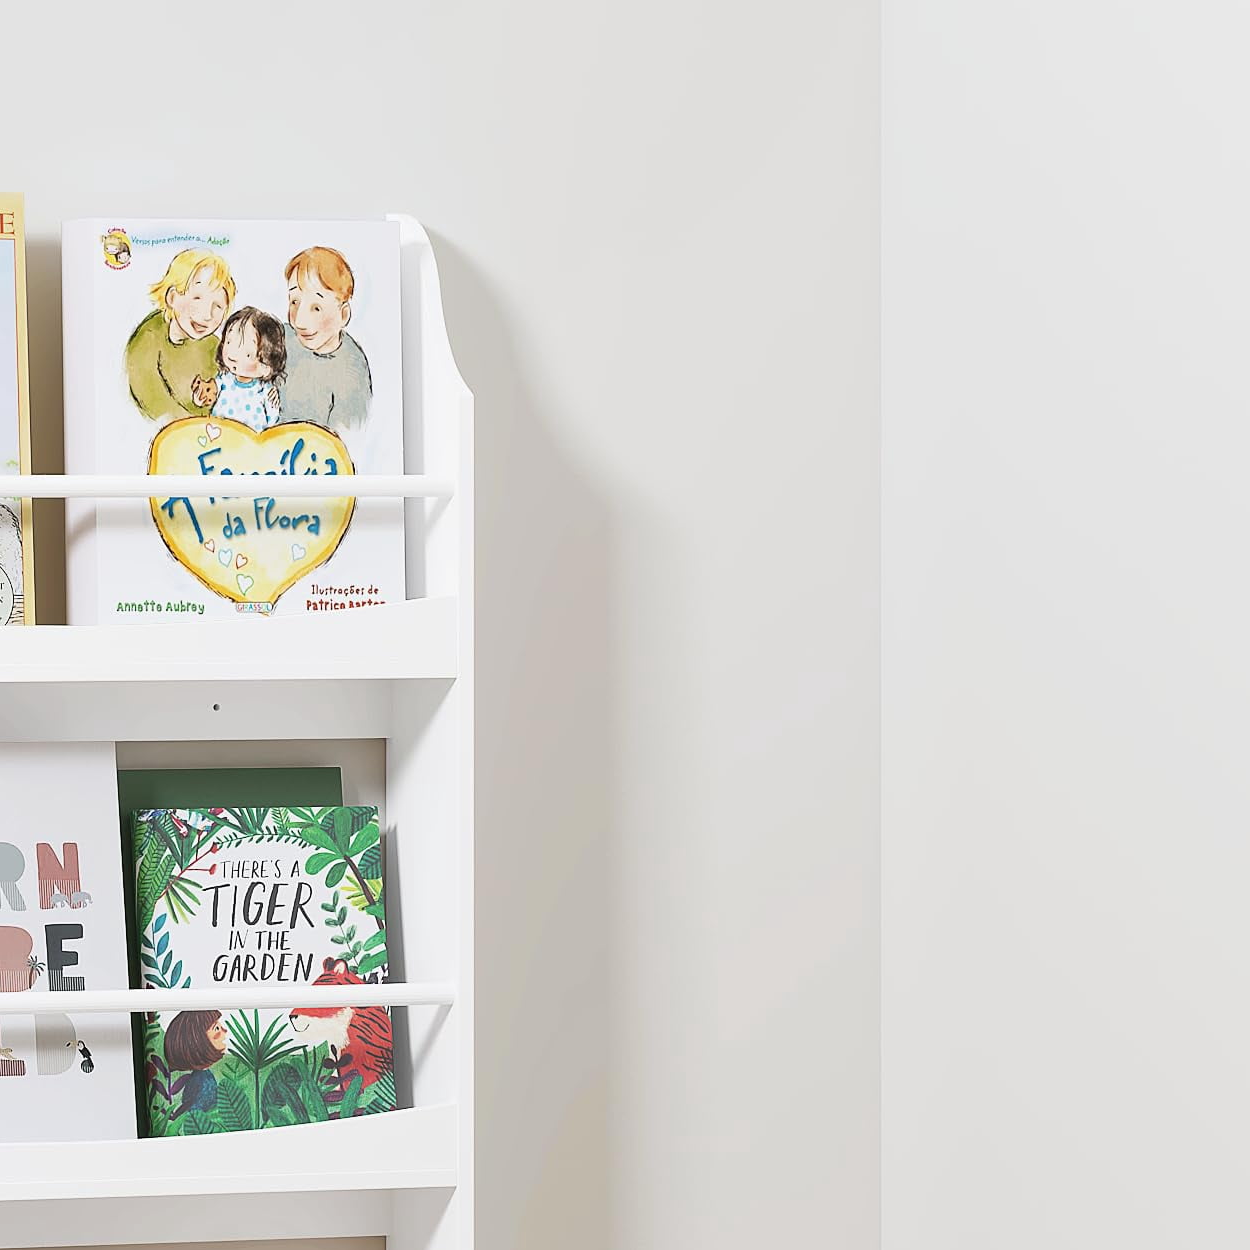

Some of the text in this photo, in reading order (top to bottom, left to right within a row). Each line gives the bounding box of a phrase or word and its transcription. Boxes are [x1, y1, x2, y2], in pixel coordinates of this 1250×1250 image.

[167, 234, 195, 243] entender
[223, 497, 321, 539] da Flora
[311, 584, 379, 596] Ilustrações de
[116, 600, 205, 615] Annette Aubrey
[220, 860, 300, 878] THERE'S A
[202, 882, 314, 929] TIGER
[229, 929, 291, 950] IN THE
[213, 953, 313, 982] GARDEN
